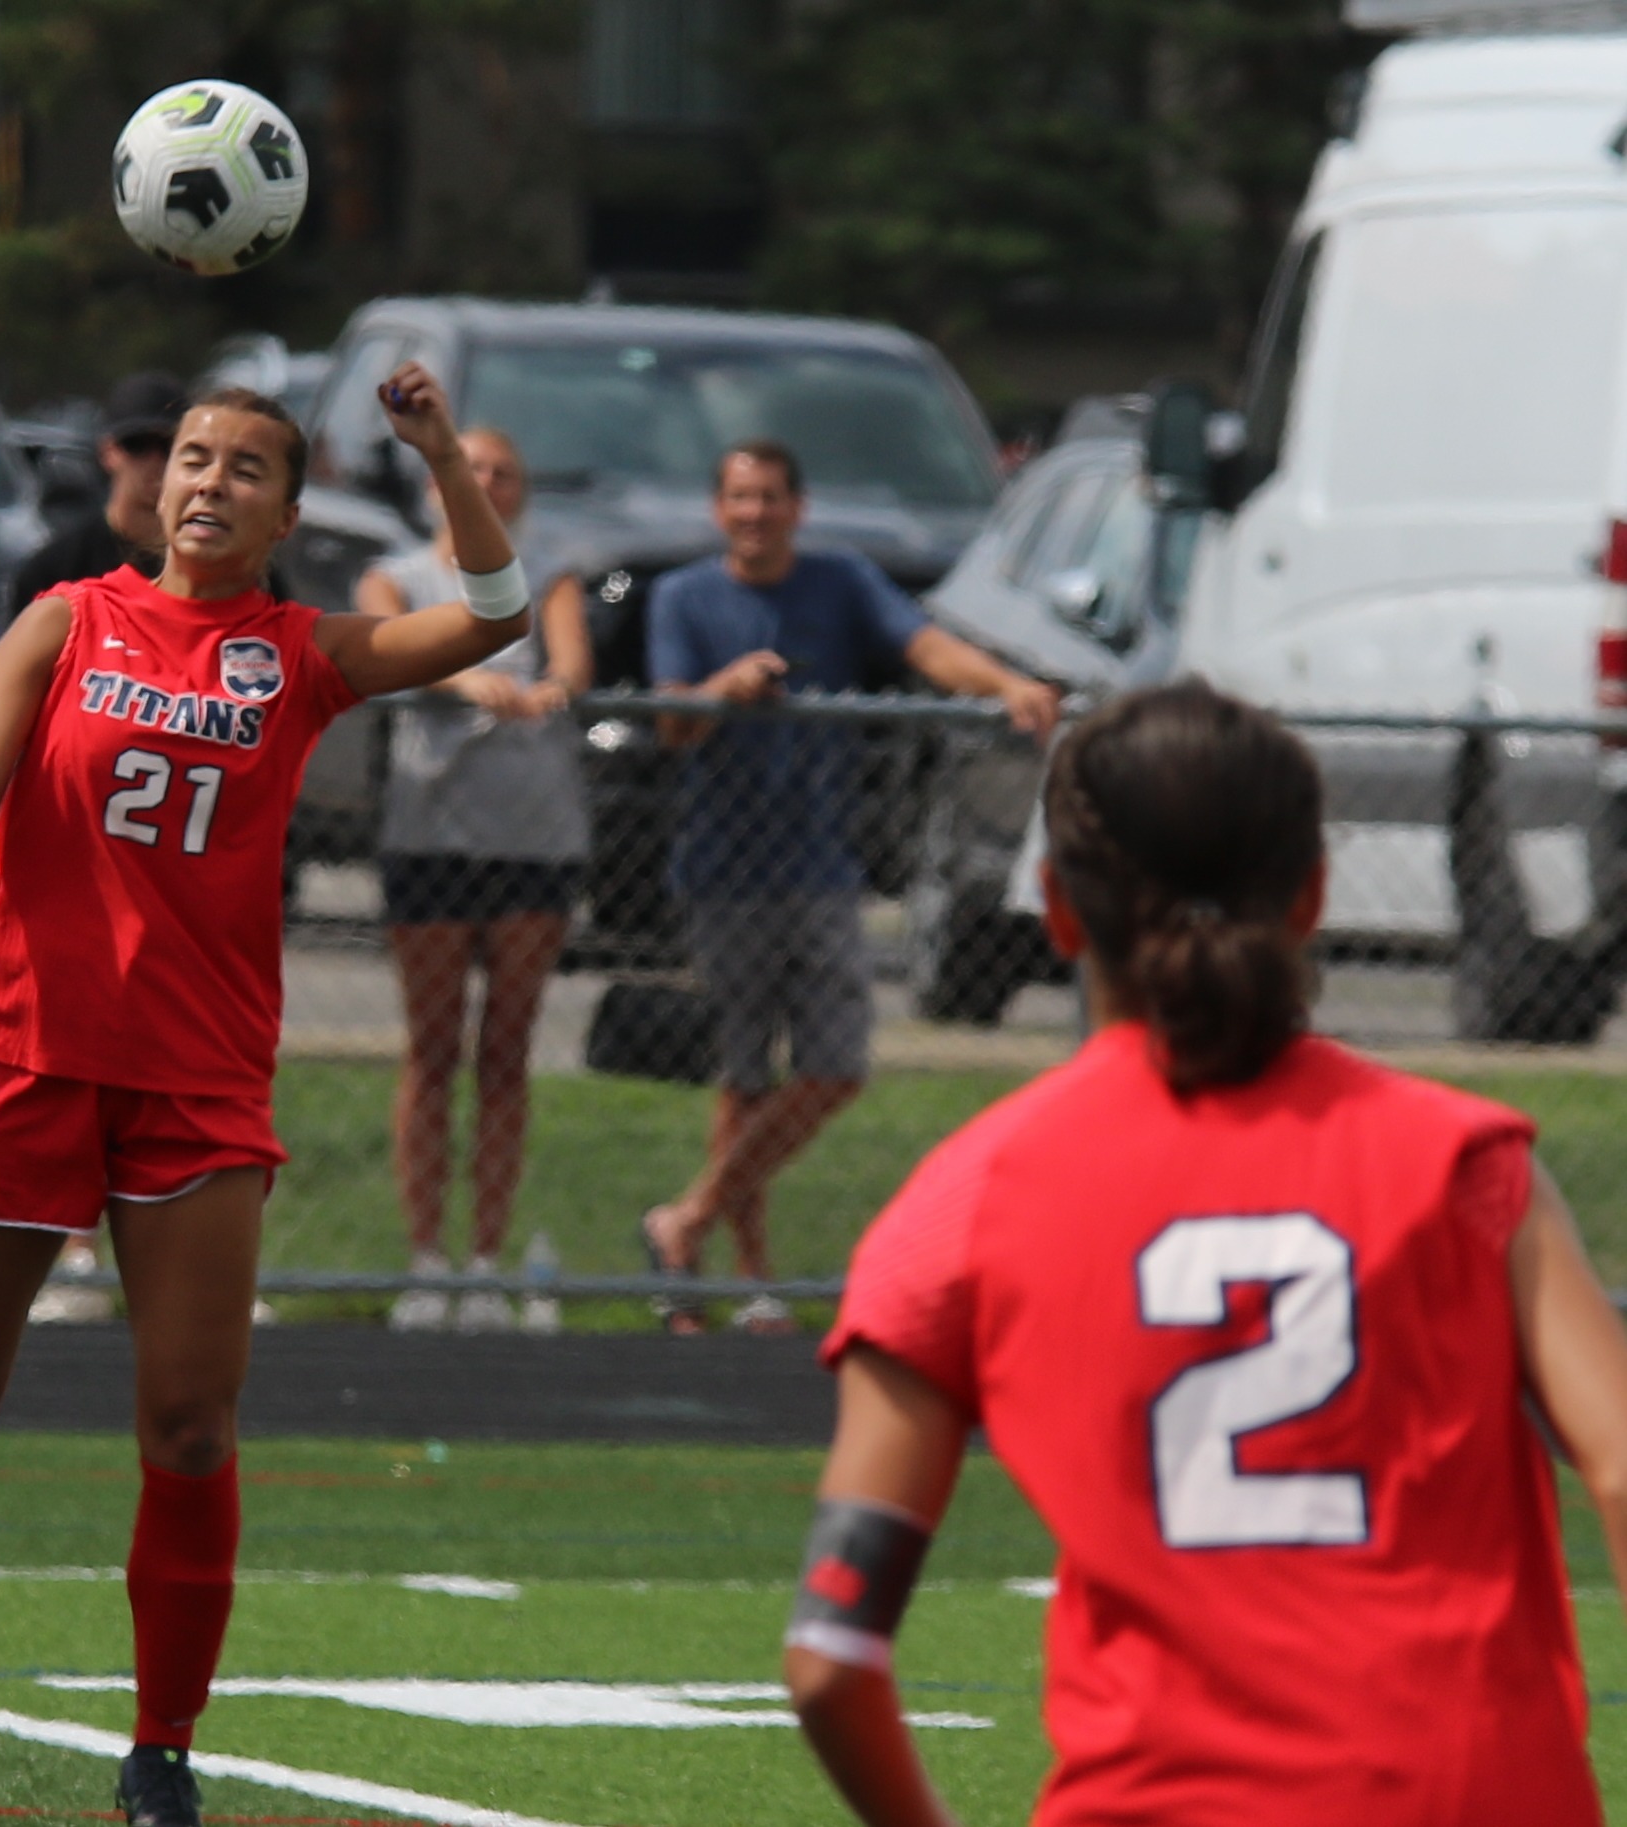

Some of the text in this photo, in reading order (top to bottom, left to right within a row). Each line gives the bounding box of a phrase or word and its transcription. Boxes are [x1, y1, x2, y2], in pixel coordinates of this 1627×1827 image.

[80, 669, 265, 749] TITANS
[104, 748, 223, 854] 21
[1134, 1210, 1371, 1550] 2
